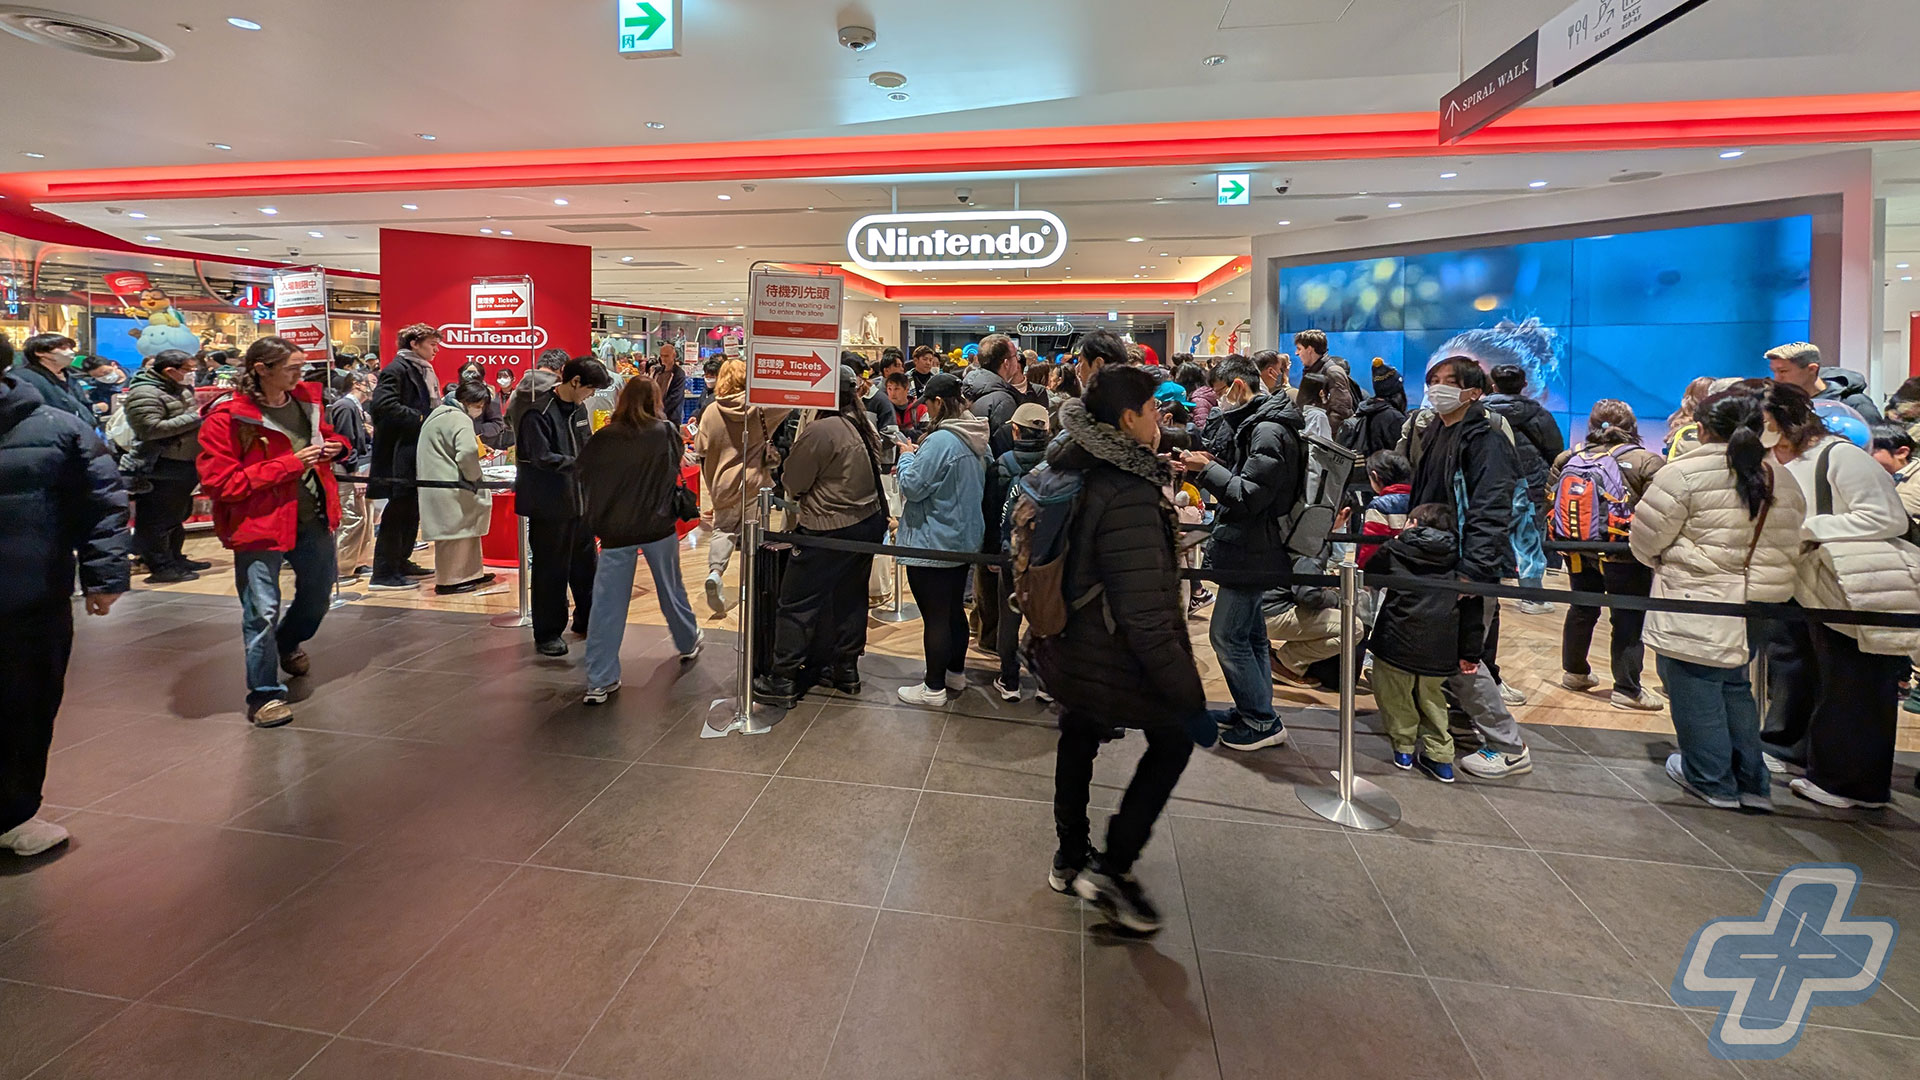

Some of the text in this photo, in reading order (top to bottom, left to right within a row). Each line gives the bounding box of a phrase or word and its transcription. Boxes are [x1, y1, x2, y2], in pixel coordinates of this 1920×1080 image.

[1622, 6, 1641, 22] EAST
[1594, 27, 1612, 42] EAST
[1462, 58, 1530, 111] SPIRAL WALK
[867, 225, 1045, 256] Nintendo
[766, 284, 830, 300] 待機列先頭
[798, 302, 822, 310] waiting
[447, 329, 538, 343] Nintendo
[466, 355, 520, 365] TOKYO
[790, 360, 822, 370] Tickets
